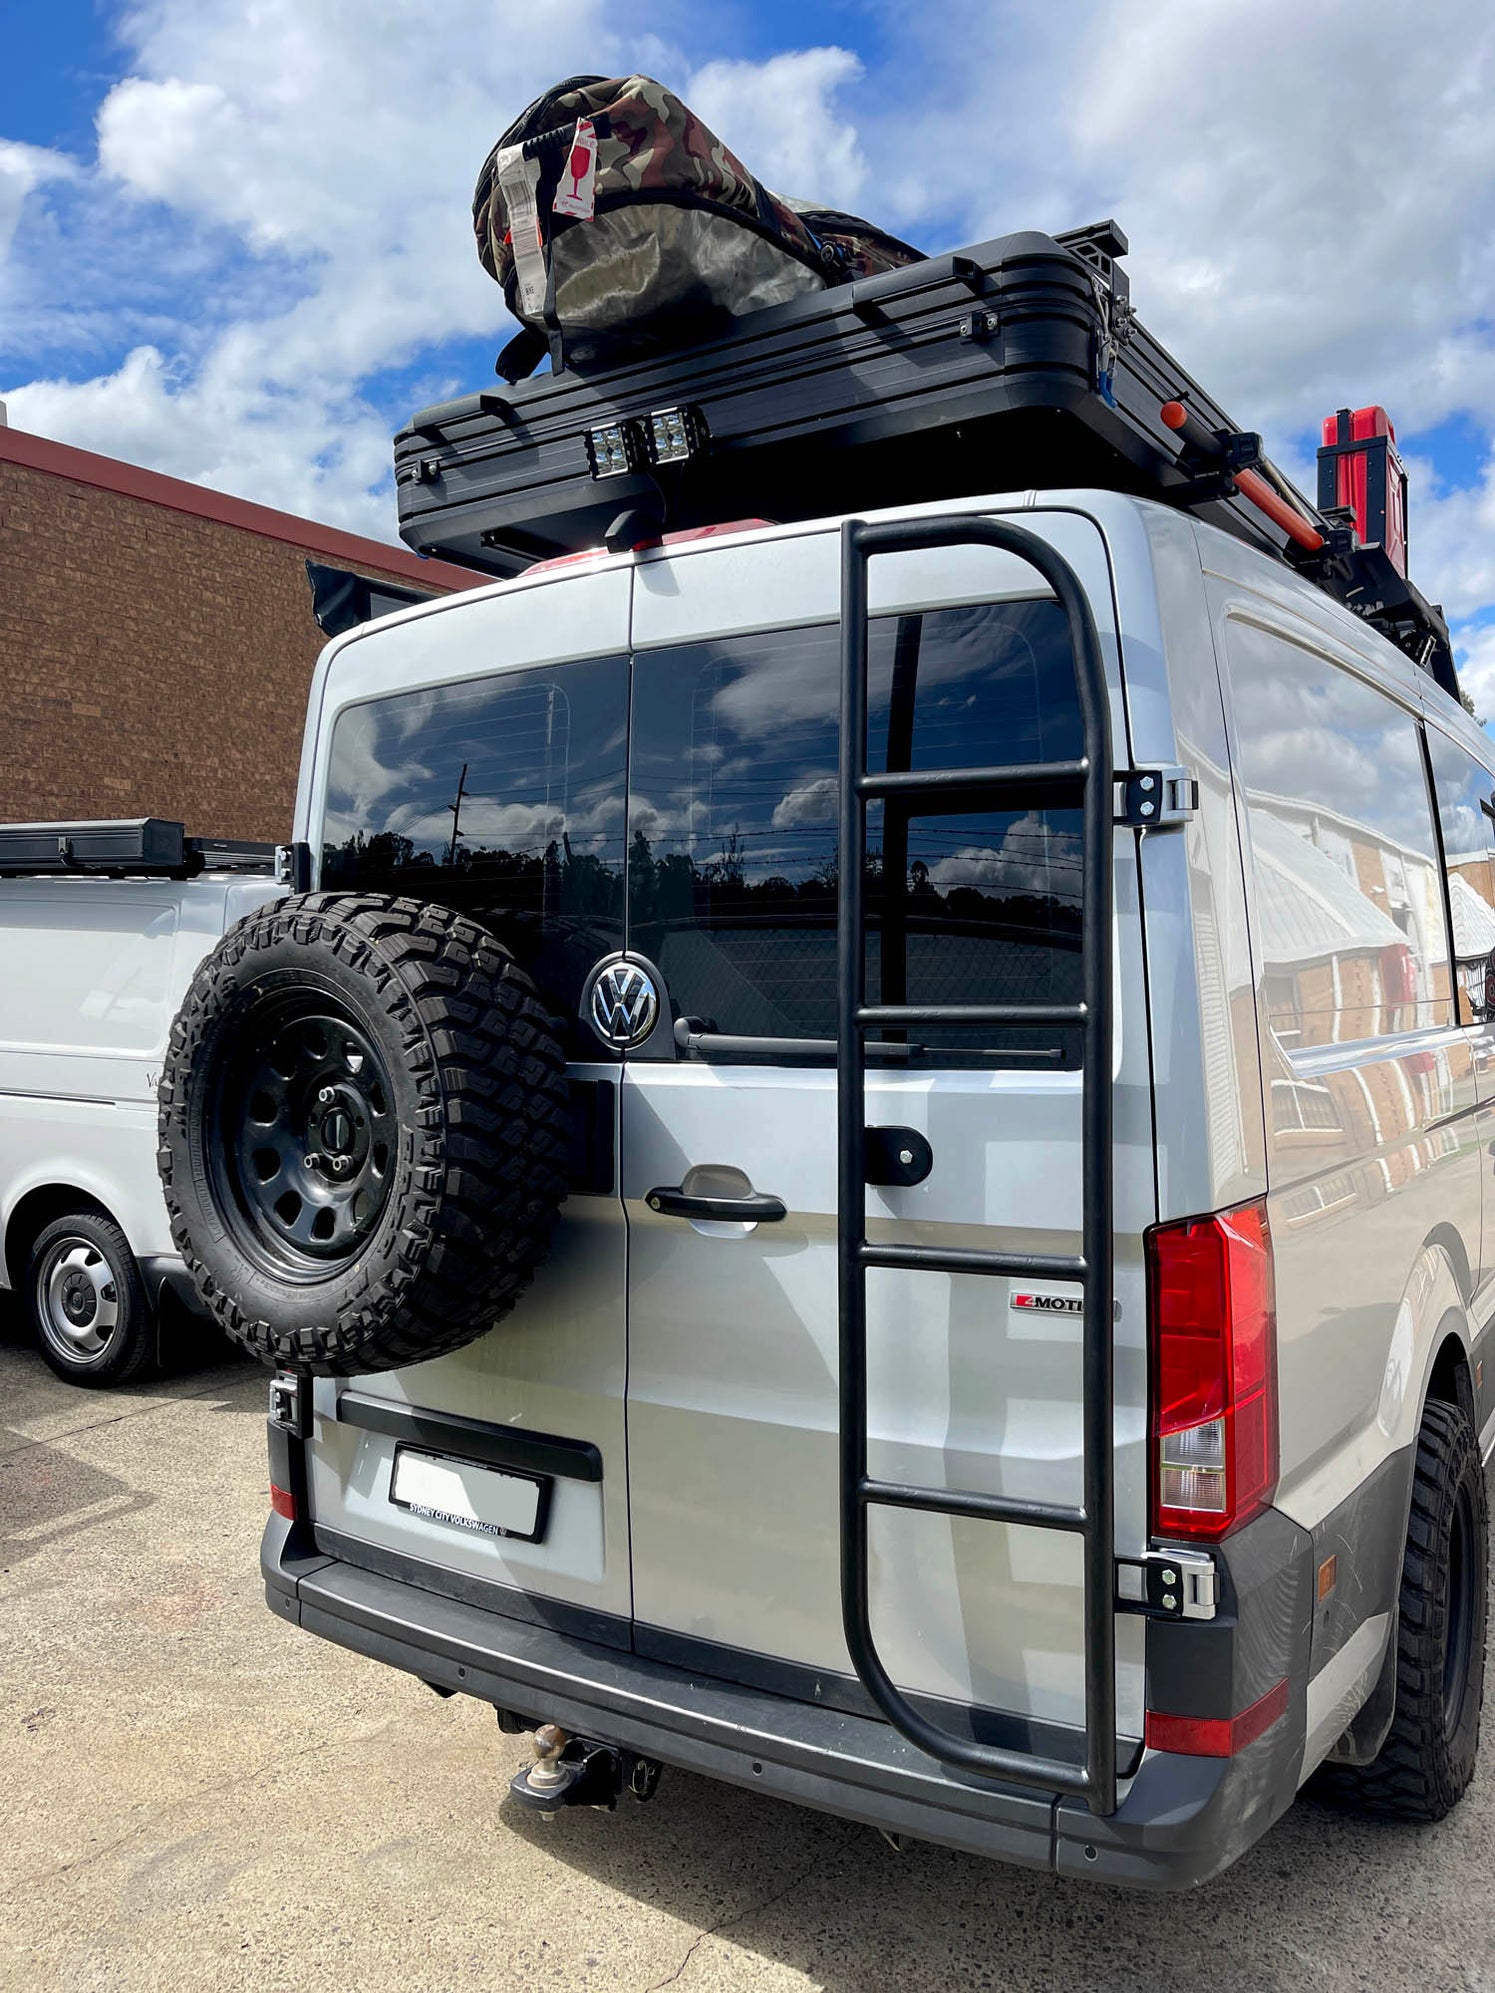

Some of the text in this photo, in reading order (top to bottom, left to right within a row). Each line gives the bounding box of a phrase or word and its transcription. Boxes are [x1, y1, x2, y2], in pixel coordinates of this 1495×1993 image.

[593, 963, 656, 1041] VW
[1016, 1295, 1084, 1311] 4MOTI
[409, 1503, 436, 1518] SYDNEY
[435, 1510, 451, 1521] CITY
[450, 1515, 499, 1535] VOLKSWAGEN
